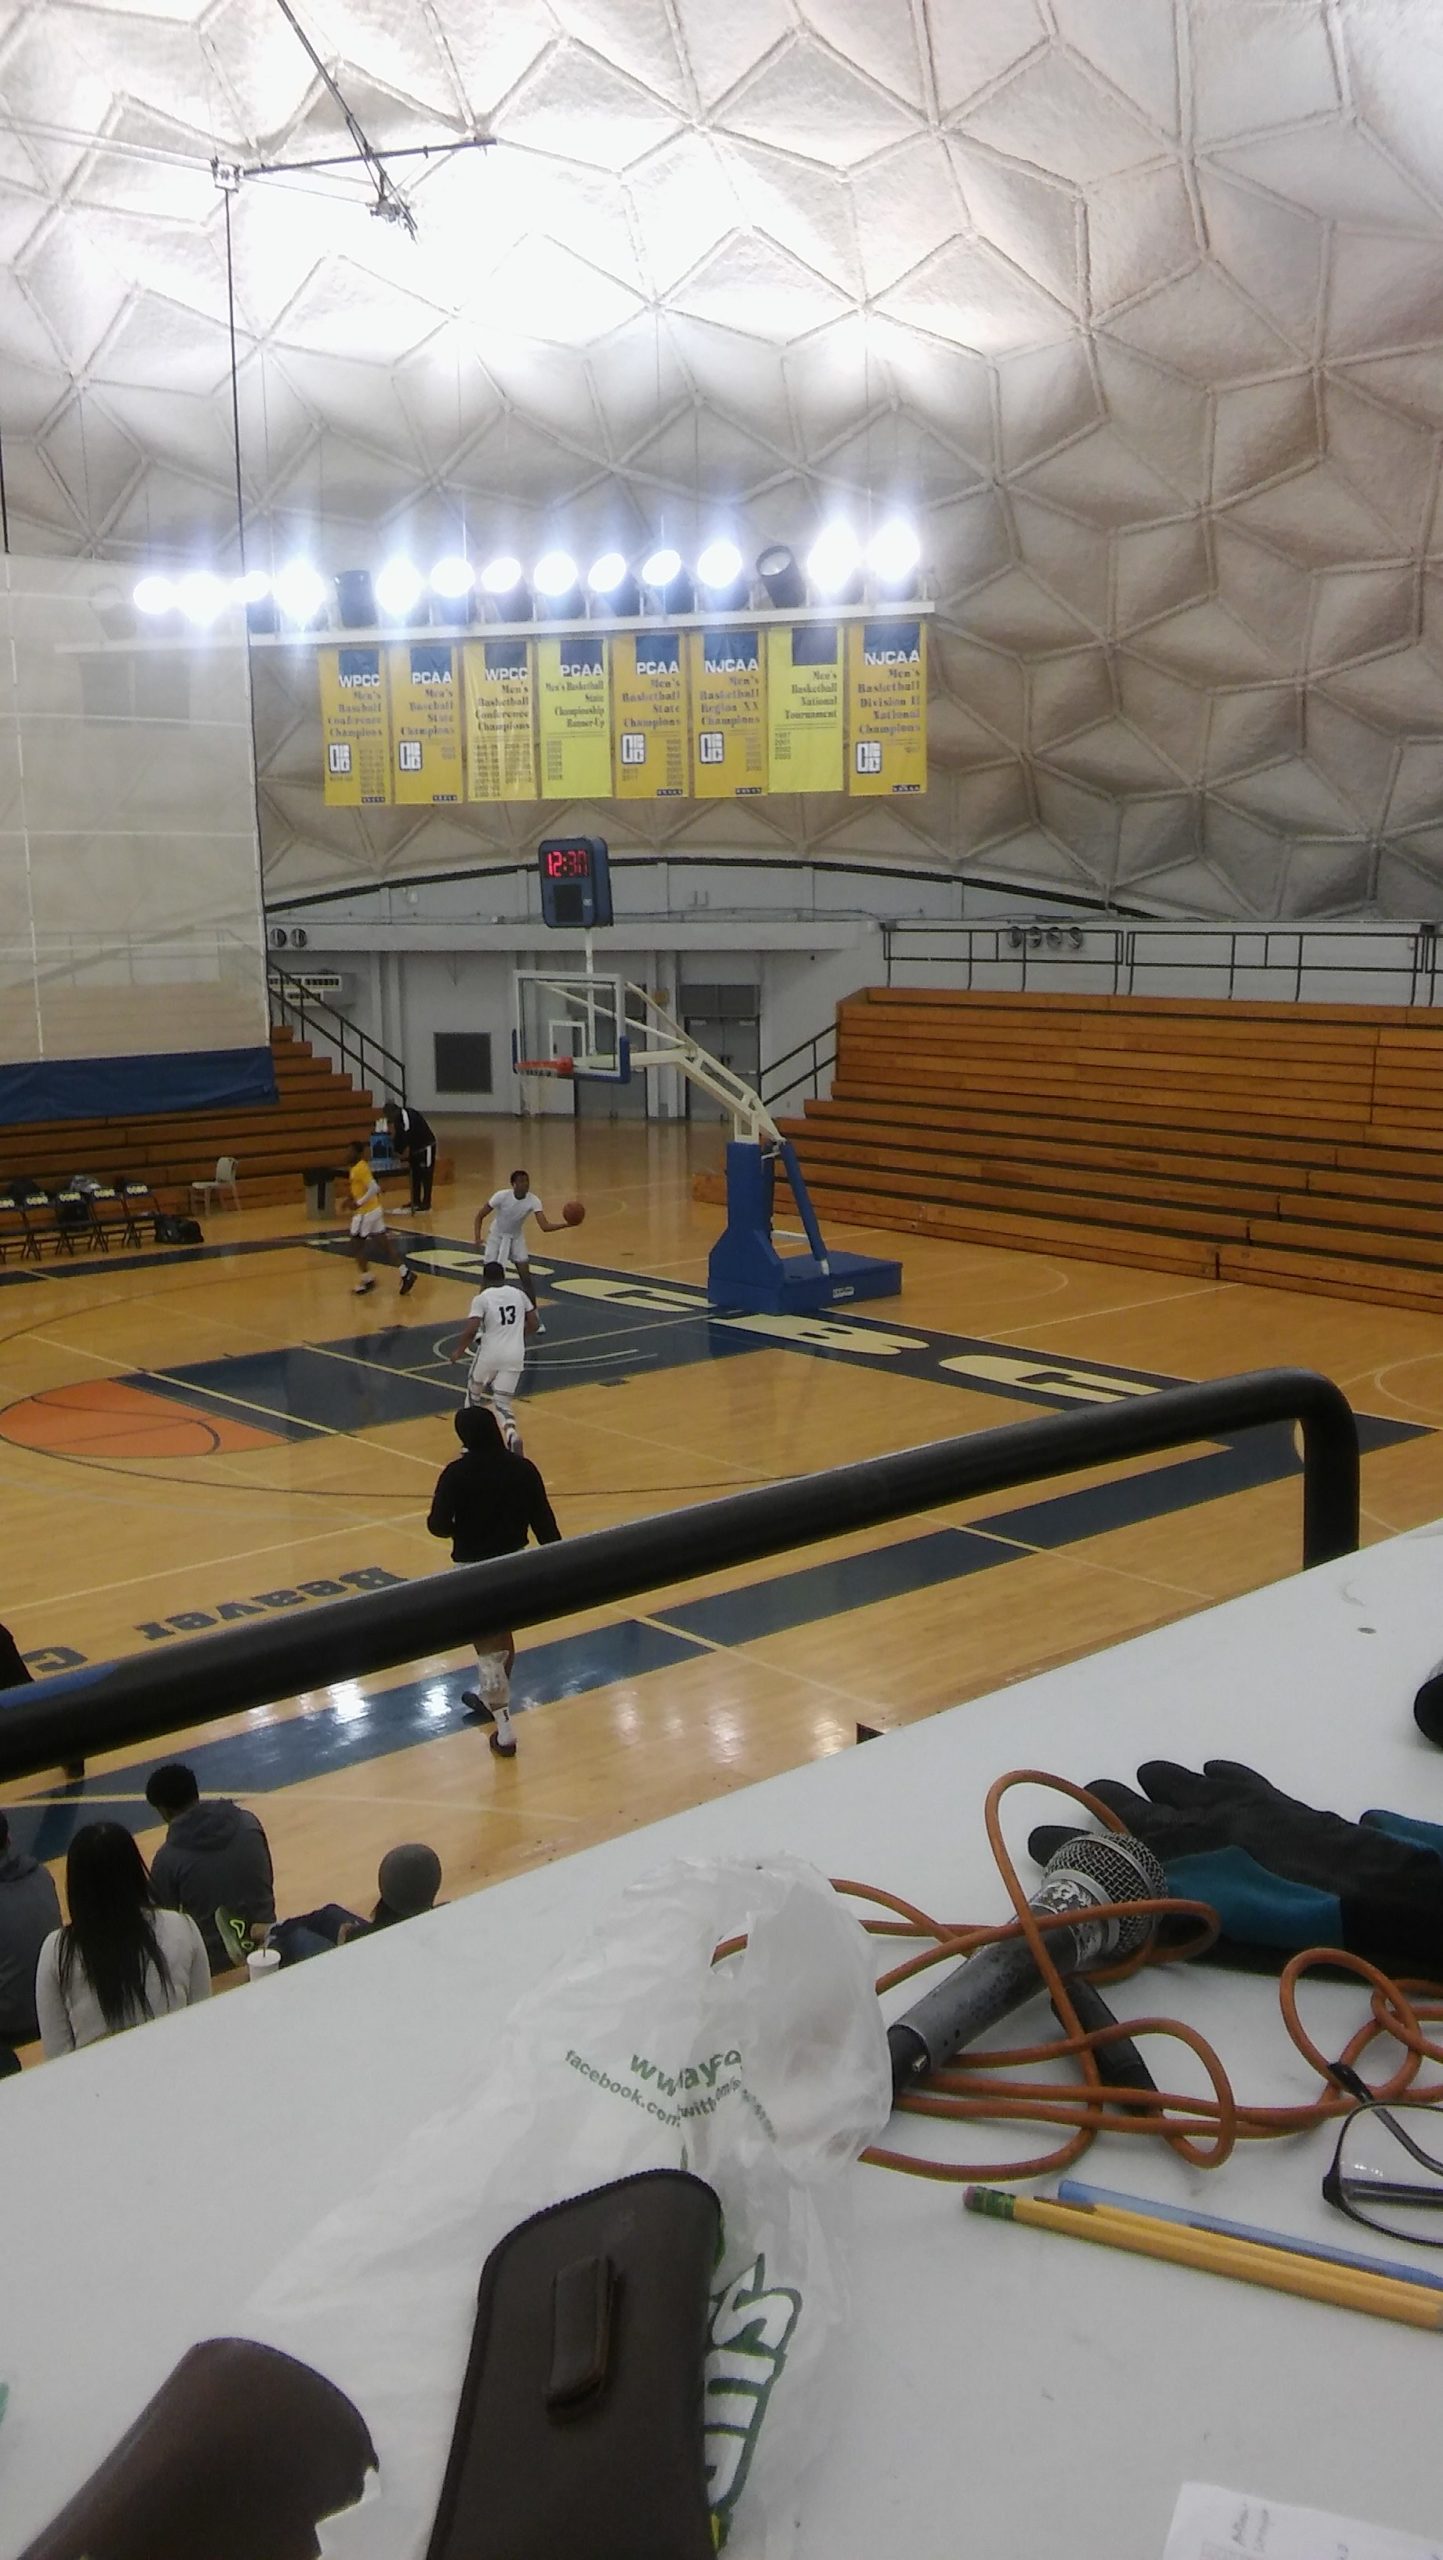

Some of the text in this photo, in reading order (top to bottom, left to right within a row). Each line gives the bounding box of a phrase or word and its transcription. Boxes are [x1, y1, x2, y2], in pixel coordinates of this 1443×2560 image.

[864, 650, 921, 665] NJCAA
[561, 664, 603, 677] PCAA
[637, 661, 679, 675] PCAA
[705, 659, 758, 673] NJCAA
[412, 671, 452, 685] PCAA
[485, 667, 528, 681] WPCC
[813, 671, 837, 680] Men's
[889, 668, 920, 678] Men's
[339, 674, 380, 688] WPCC
[567, 681, 604, 690] Basketball
[651, 679, 680, 687] Men's
[730, 676, 759, 685] Men's
[502, 682, 528, 693] Men's
[791, 683, 837, 694] Basketball
[858, 681, 920, 693] Basketball
[354, 691, 381, 700] Men's
[425, 688, 453, 697] Men's
[622, 691, 680, 702] Basketball
[700, 689, 759, 699] Basketball
[478, 697, 528, 707] Basketball
[801, 697, 837, 706] National
[860, 698, 906, 707] Division
[653, 704, 679, 713] State
[701, 704, 737, 714] Region
[475, 709, 528, 719] Conference
[785, 710, 837, 719] Tournament
[873, 710, 920, 719] National
[328, 716, 381, 725] Conference
[624, 717, 680, 729] Champions
[701, 716, 760, 727] Champions
[401, 726, 454, 737] Champions
[478, 721, 529, 732] Champions
[859, 723, 920, 735] Champions
[330, 729, 382, 739] Champions
[499, 1305, 516, 1326] 13
[133, 1567, 409, 1641] Beaver
